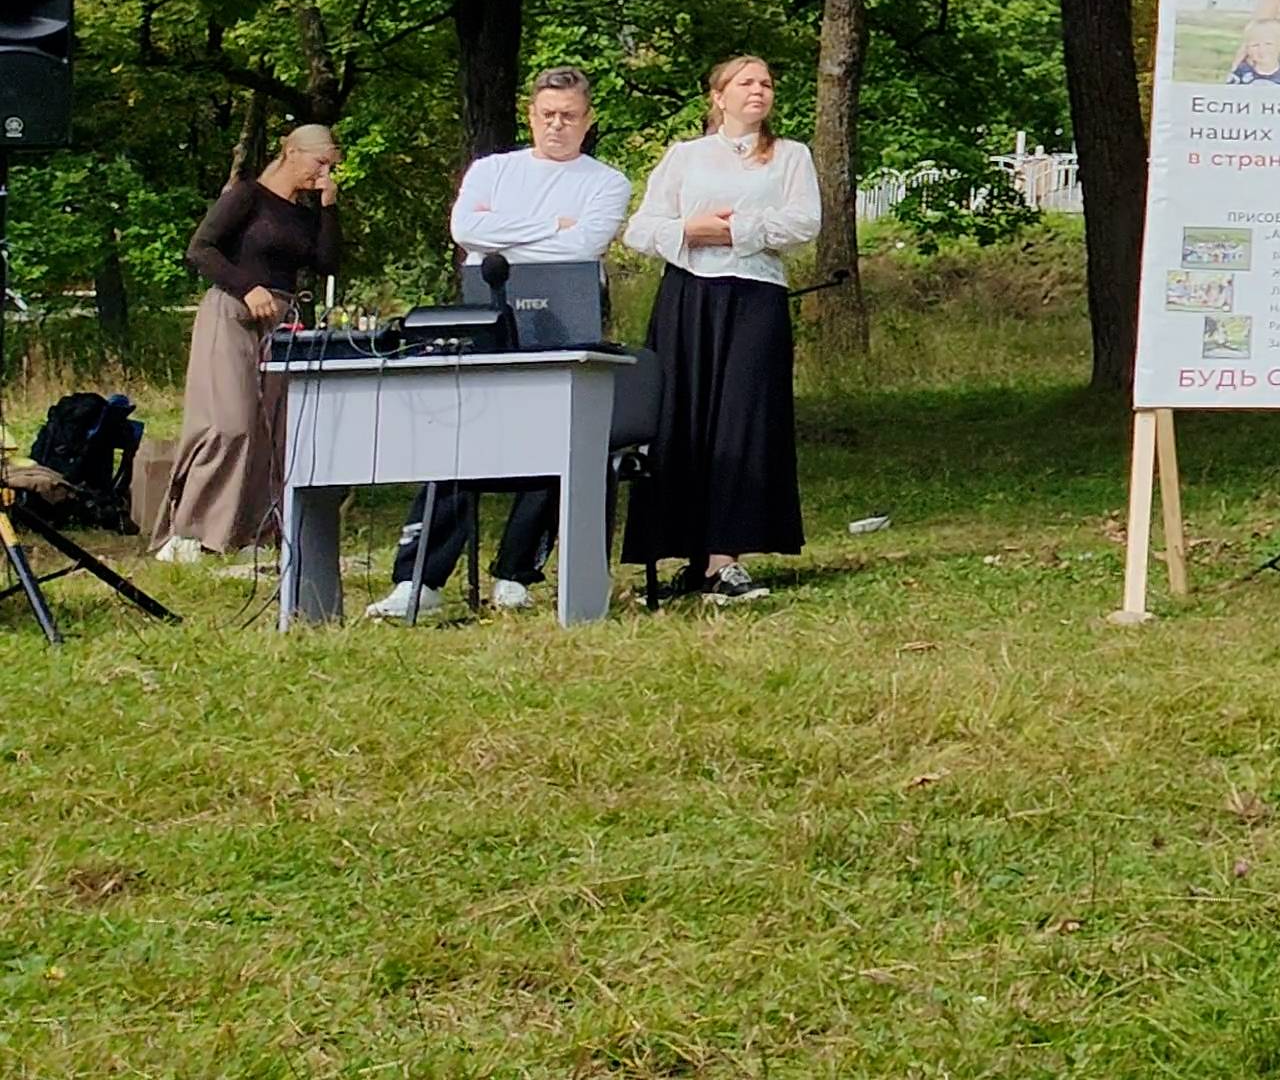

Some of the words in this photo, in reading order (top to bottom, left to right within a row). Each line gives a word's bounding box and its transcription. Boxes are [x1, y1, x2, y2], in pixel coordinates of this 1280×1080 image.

[1191, 96, 1250, 115] Если
[1190, 126, 1272, 141] наших
[1188, 151, 1201, 165] в
[1178, 369, 1258, 392] БУДЬ
